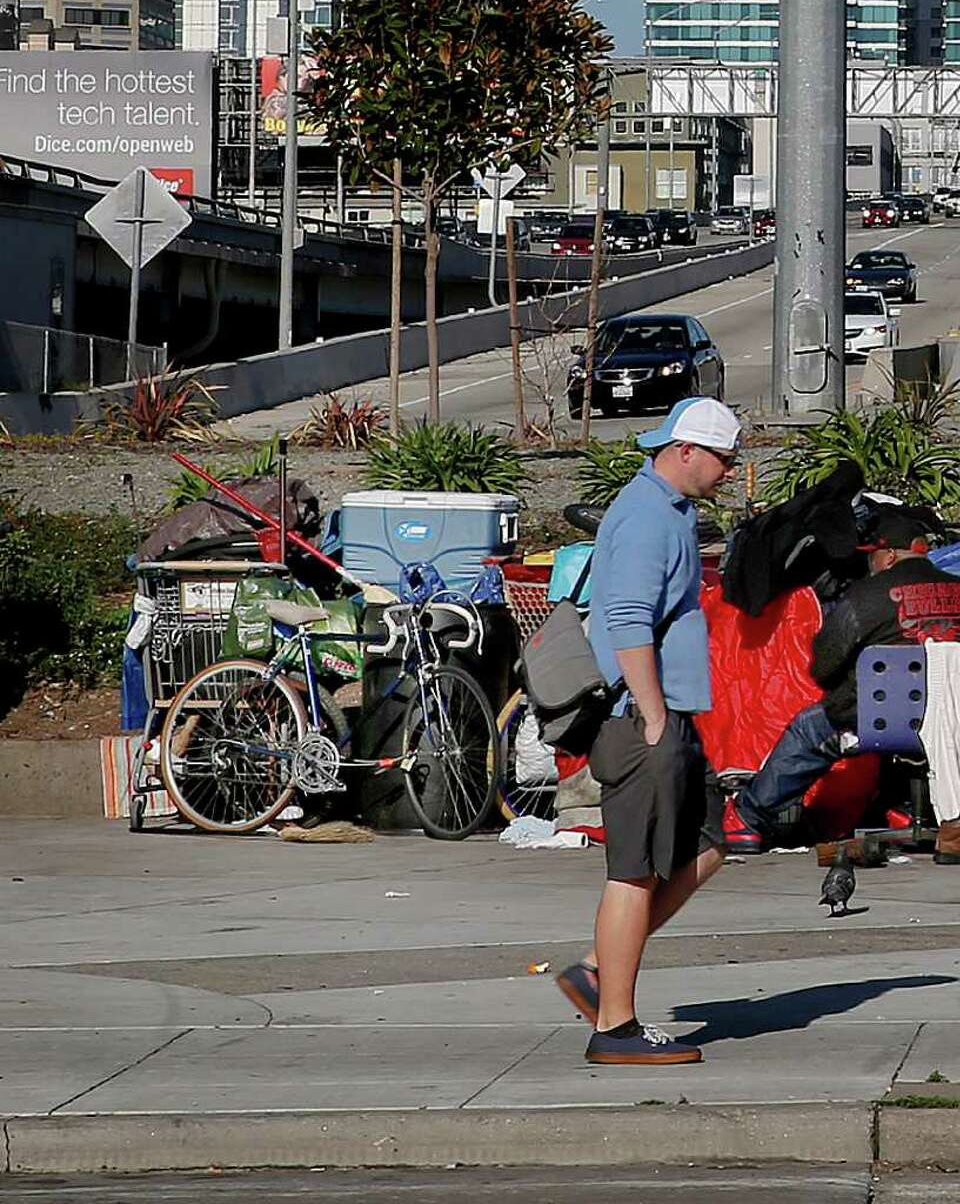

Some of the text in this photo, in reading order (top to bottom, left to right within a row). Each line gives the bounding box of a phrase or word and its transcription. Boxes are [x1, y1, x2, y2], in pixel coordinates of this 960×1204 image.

[54, 69, 96, 94] the
[106, 69, 195, 94] hottest
[57, 102, 199, 126] tech talent.
[35, 136, 194, 156] Dice.com/openweb
